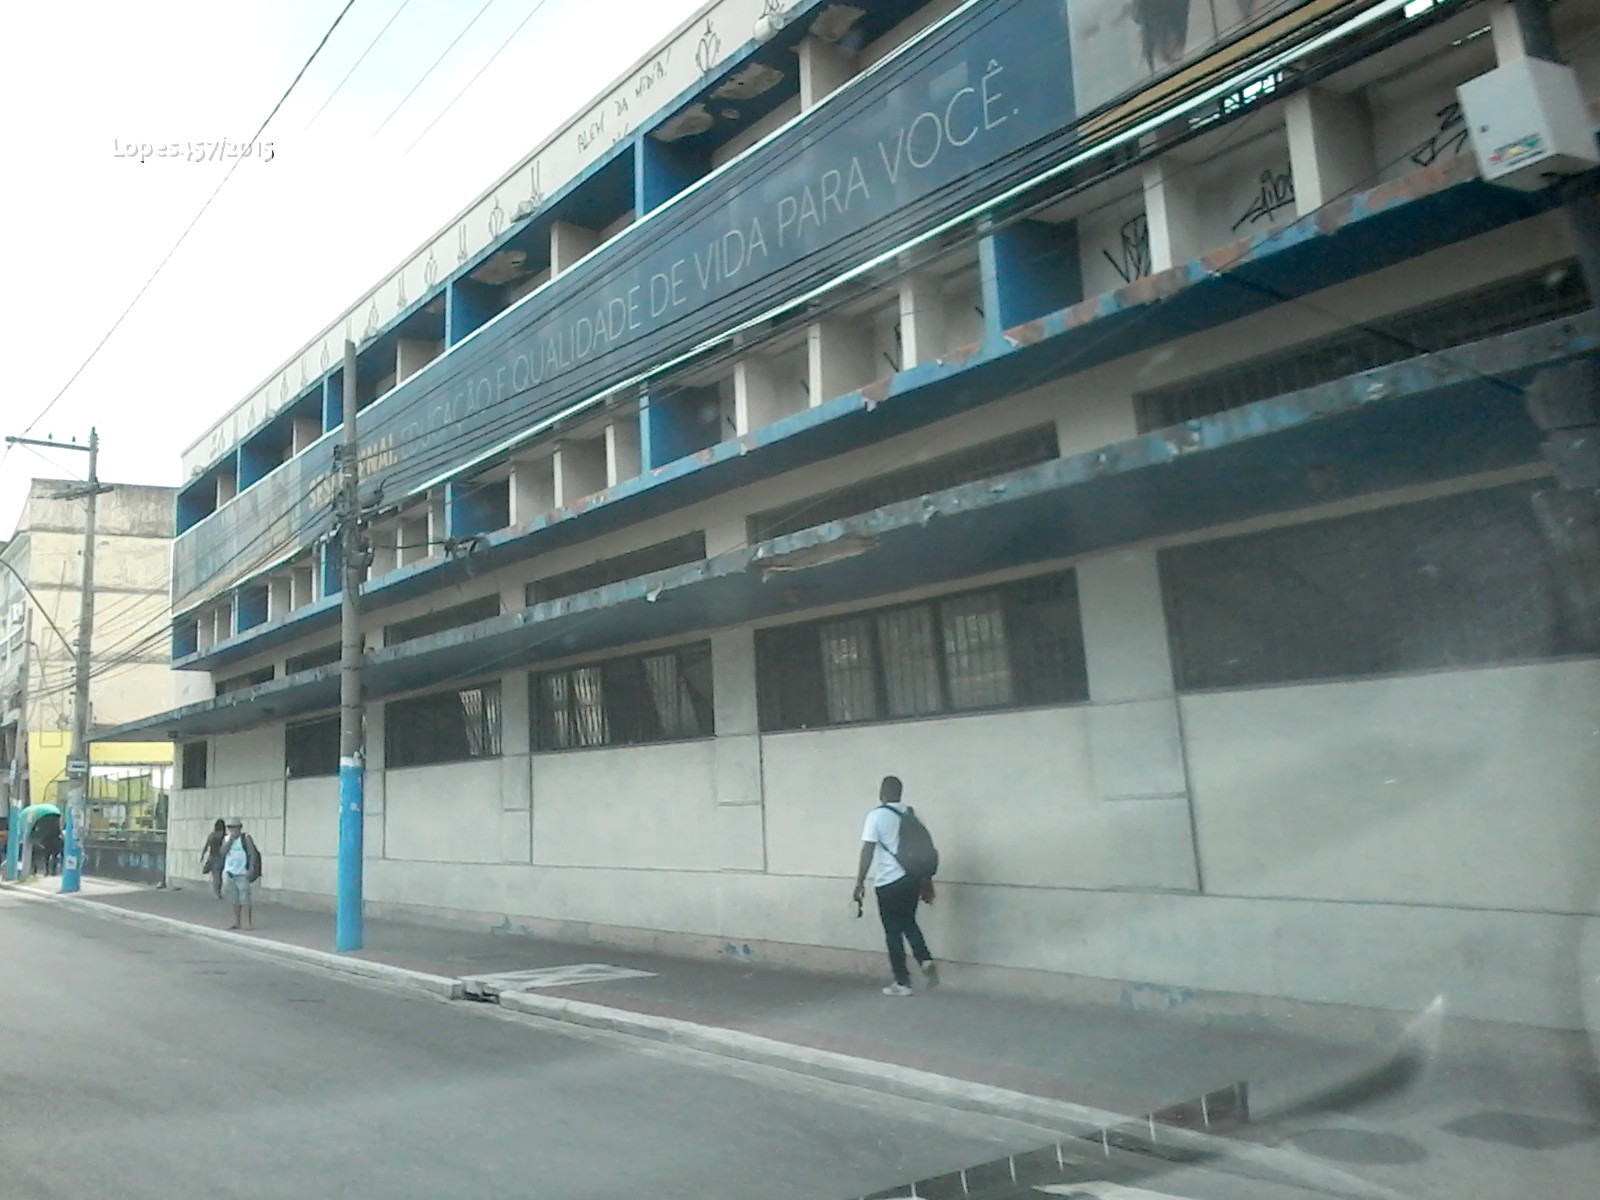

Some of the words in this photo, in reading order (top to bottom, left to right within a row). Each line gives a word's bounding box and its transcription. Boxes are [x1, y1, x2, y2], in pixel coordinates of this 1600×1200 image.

[401, 377, 492, 461] EDUCAÇÃO
[512, 285, 642, 392] QUALIDADE
[650, 258, 688, 319] DE
[694, 216, 768, 291] VIDA
[777, 156, 870, 249] PARA
[877, 58, 1019, 185] VOCÊ.
